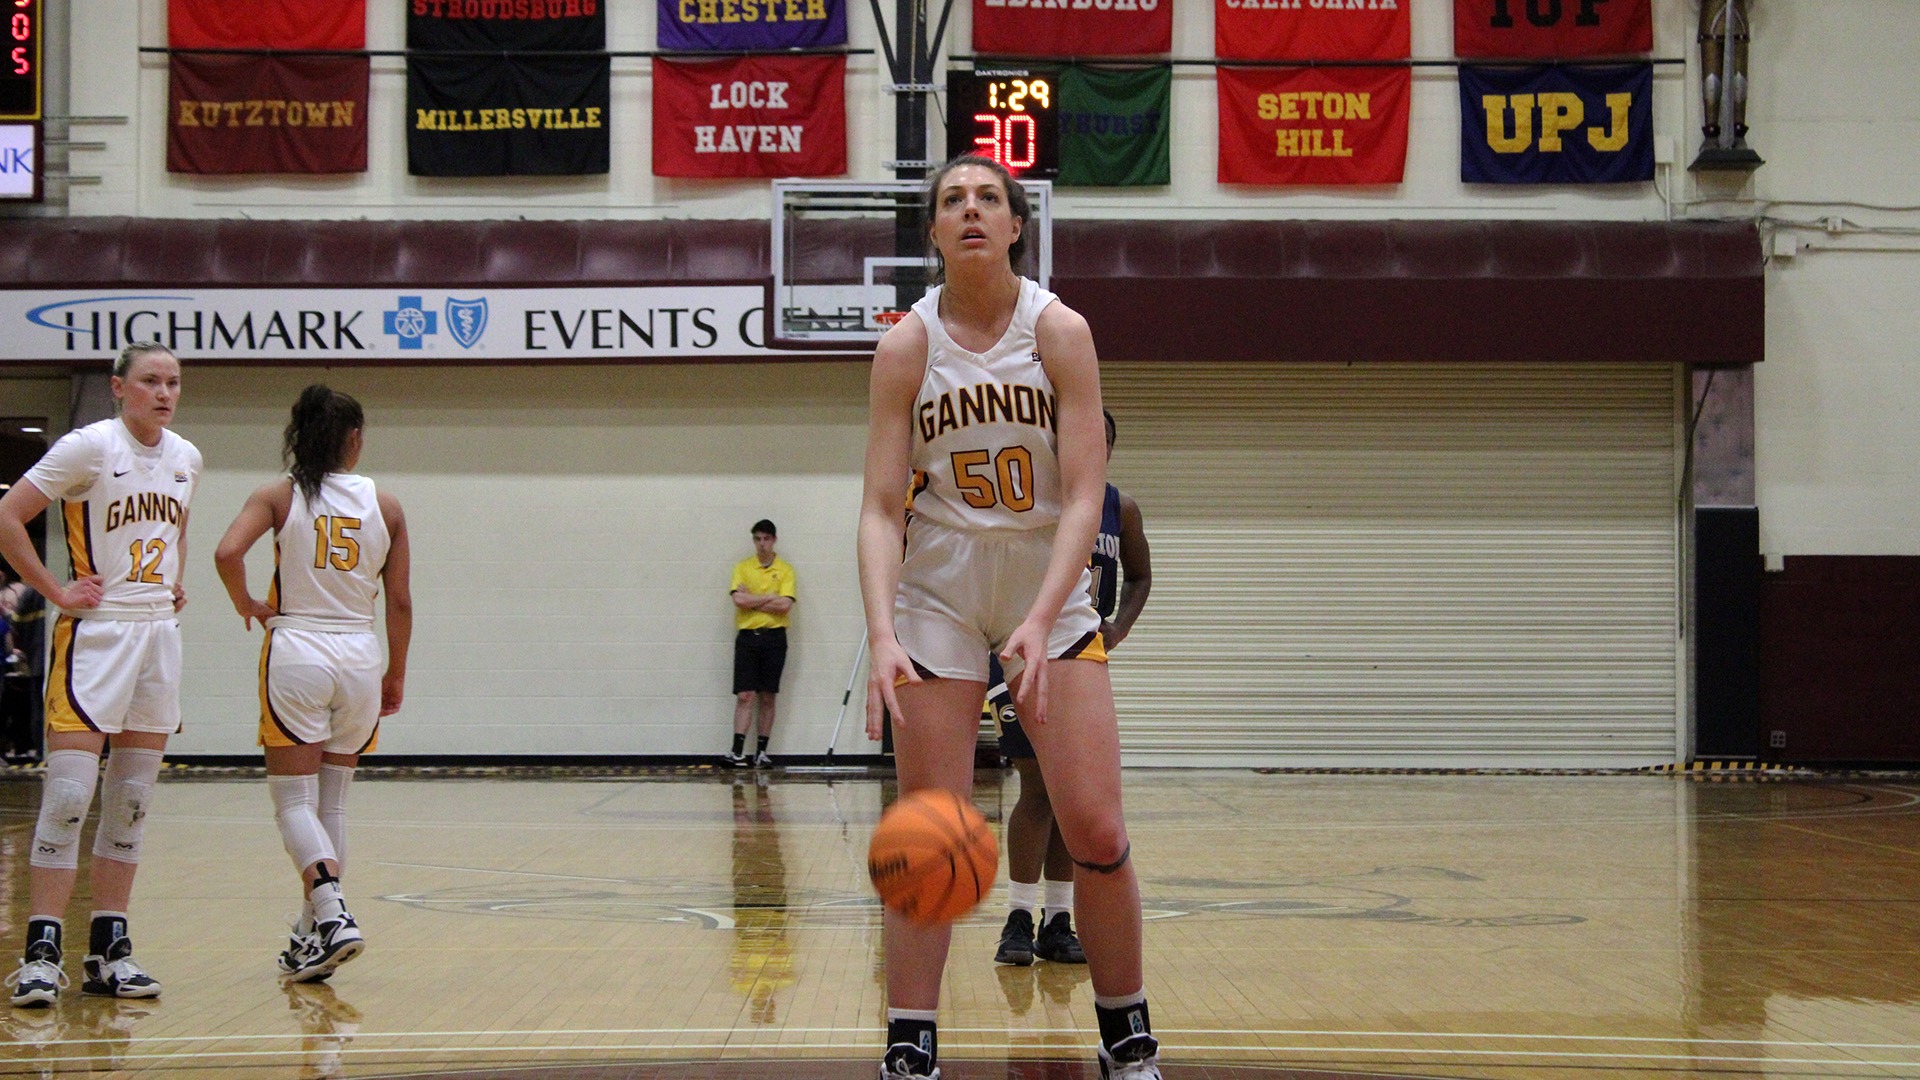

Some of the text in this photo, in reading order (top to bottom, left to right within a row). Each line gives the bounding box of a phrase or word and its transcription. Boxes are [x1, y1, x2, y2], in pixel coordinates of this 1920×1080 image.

[678, 0, 827, 23] CHESTER
[11, 13, 31, 41] 0
[709, 80, 789, 109] LOCK
[988, 79, 1050, 112] 1:29
[1257, 91, 1371, 120] SETON
[178, 101, 355, 128] KUTZTOWN
[415, 107, 602, 131] MILLERSVILLE
[1482, 91, 1632, 153] UPJ
[694, 125, 803, 153] HAVEN
[1276, 129, 1353, 157] HILL
[65, 310, 365, 350] HIGHMARK
[525, 307, 718, 350] EVENTS
[950, 445, 1034, 513] 50
[314, 514, 361, 571] 15
[126, 537, 167, 584] 12
